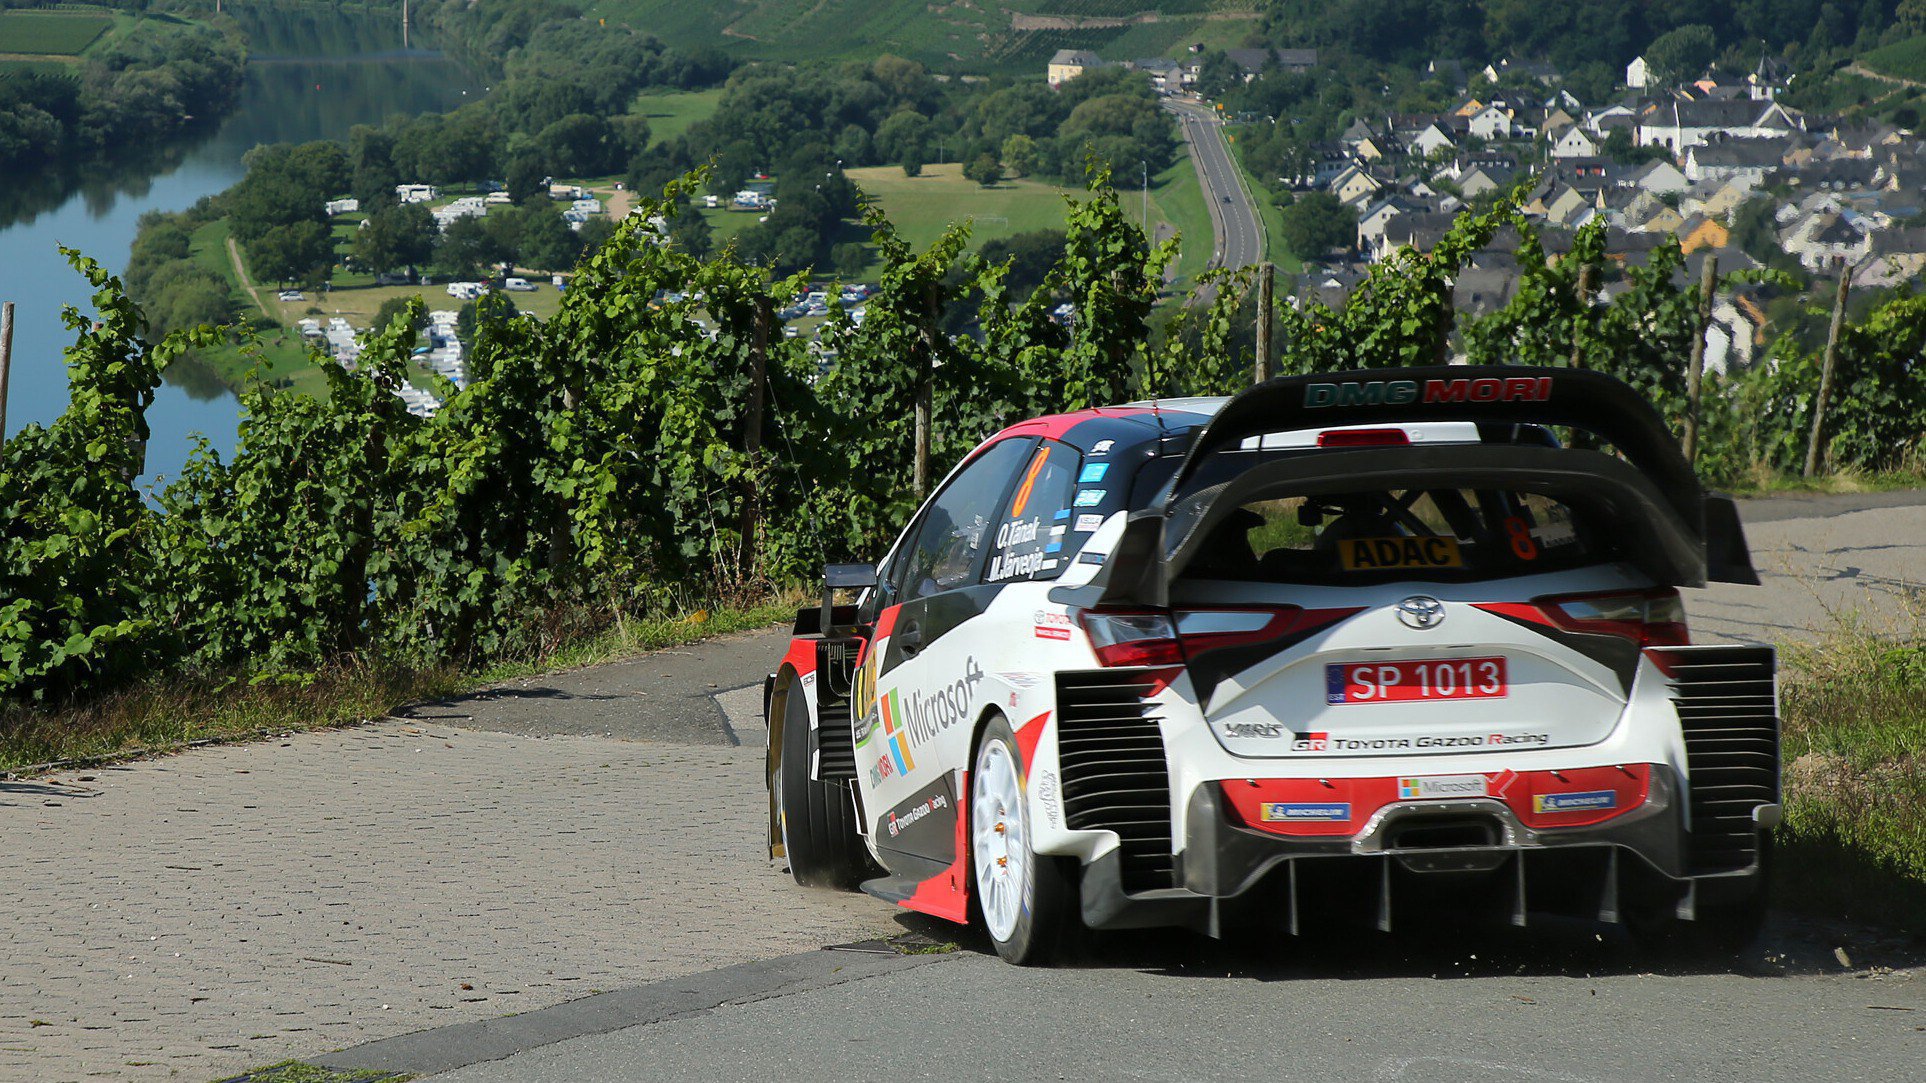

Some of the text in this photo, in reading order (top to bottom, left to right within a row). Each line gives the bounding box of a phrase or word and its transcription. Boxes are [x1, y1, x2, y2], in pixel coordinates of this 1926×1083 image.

[1304, 377, 1552, 408] DMG MORI
[1011, 446, 1051, 518] 8
[997, 516, 1040, 549] O.Tänak
[1504, 516, 1537, 560] 8
[1352, 538, 1450, 568] ADAC
[1352, 661, 1501, 700] SP 1013
[904, 654, 984, 749] Microsoft
[1225, 722, 1284, 738] YARIS
[1292, 732, 1549, 751] GR TOYOTA GAZOO Racing
[1422, 779, 1484, 793] Microsoft
[1286, 807, 1344, 816] MICHELIN
[1557, 796, 1610, 807] MICHELIN
